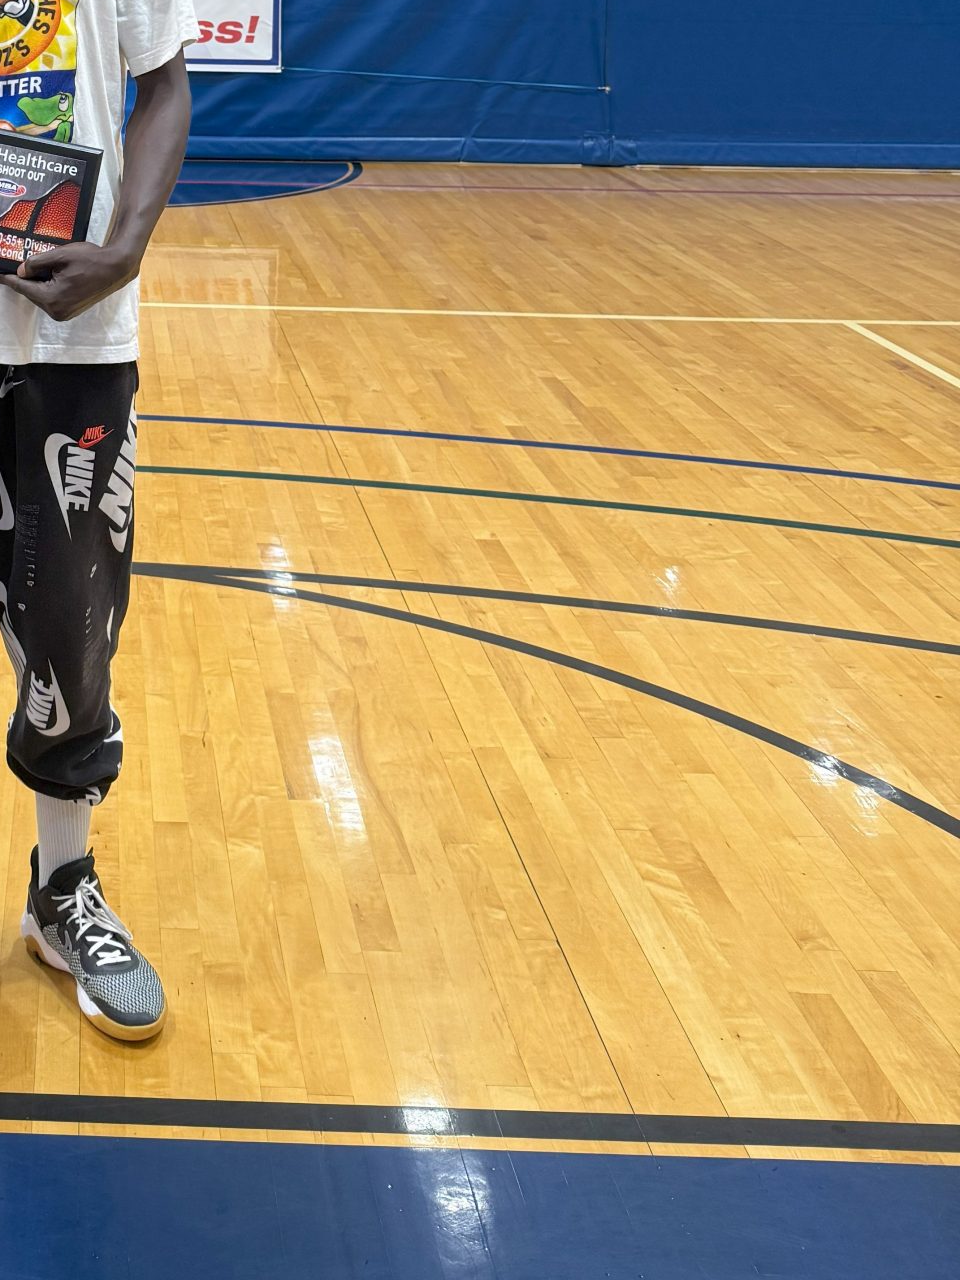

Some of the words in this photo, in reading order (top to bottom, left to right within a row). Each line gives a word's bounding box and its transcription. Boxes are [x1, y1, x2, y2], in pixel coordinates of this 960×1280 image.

[27, 170, 46, 183] OUT
[24, 238, 57, 252] Divisi
[84, 425, 105, 440] NIKE
[63, 445, 96, 512] NIKE
[26, 670, 55, 729] NIKE
